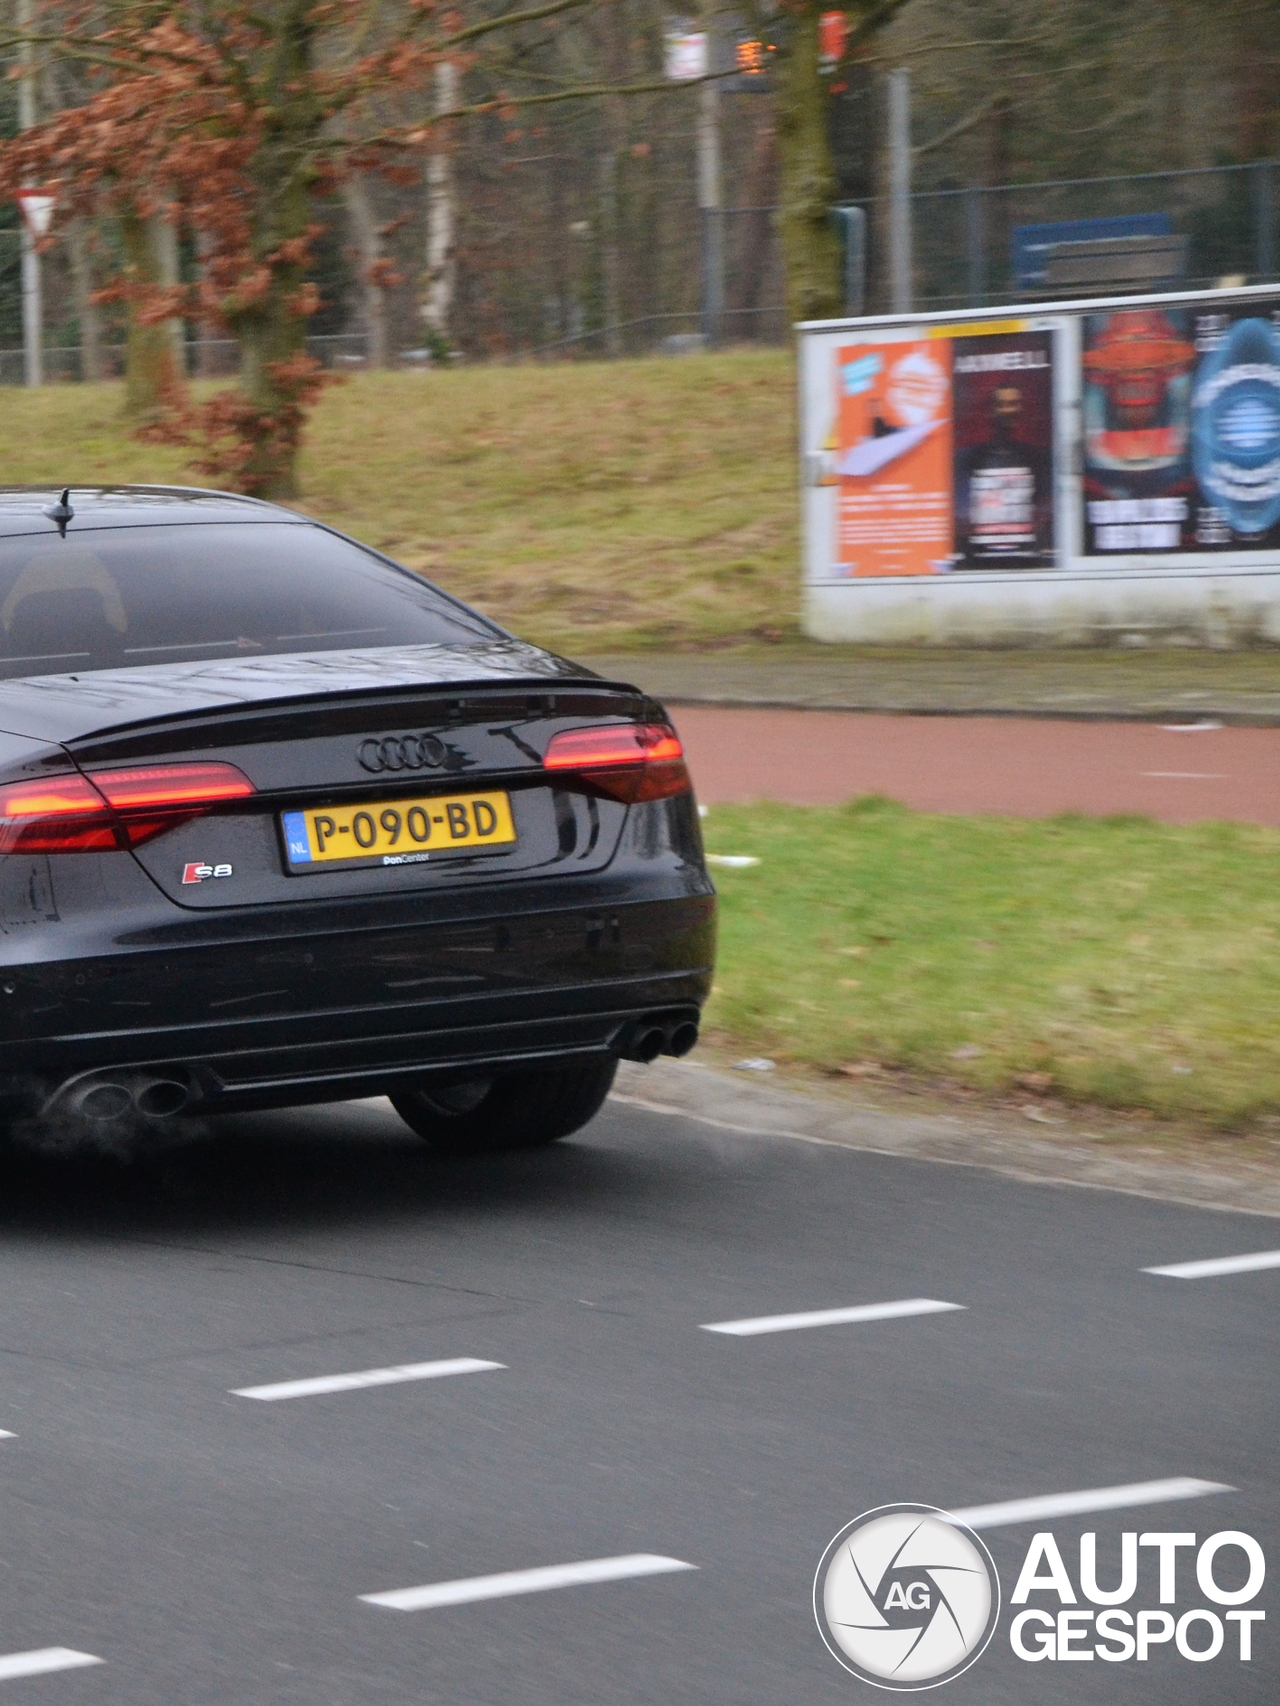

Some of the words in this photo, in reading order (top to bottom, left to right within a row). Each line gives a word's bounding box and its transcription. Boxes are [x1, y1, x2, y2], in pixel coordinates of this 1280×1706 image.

[314, 800, 497, 853] P-090-BD
[291, 842, 308, 854] NL
[383, 853, 430, 866] PonCenter
[194, 863, 233, 878] S8
